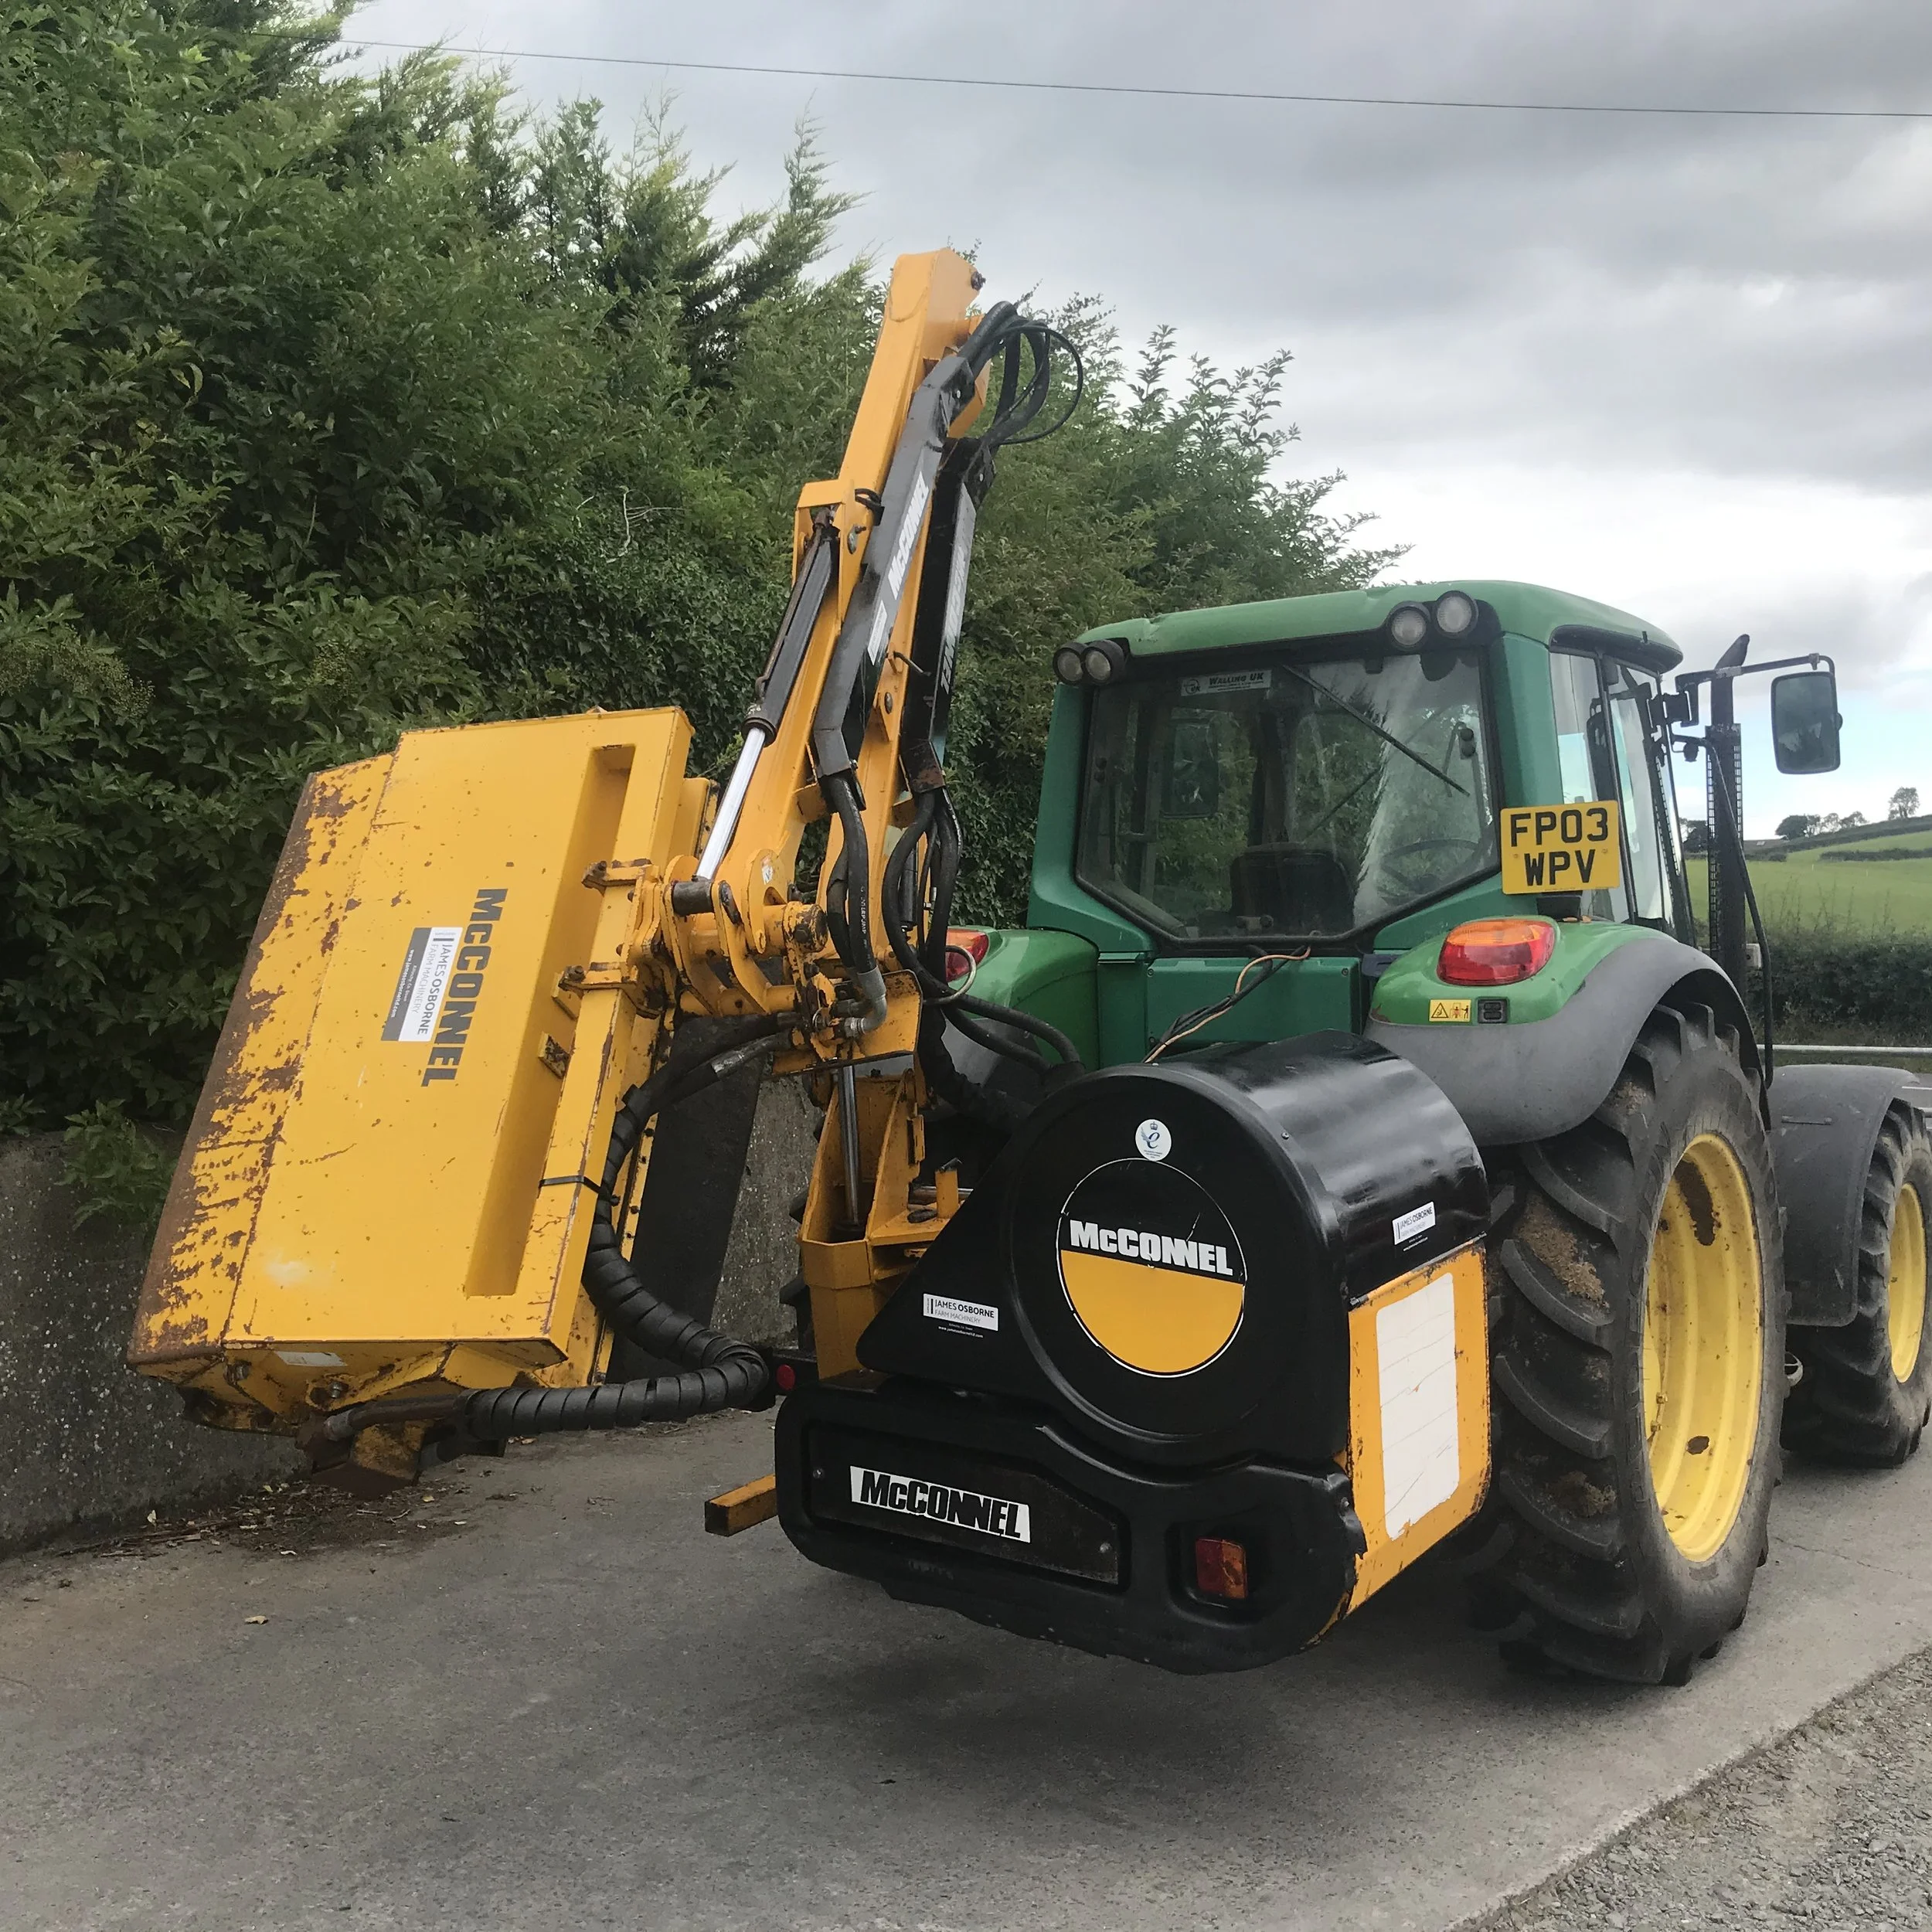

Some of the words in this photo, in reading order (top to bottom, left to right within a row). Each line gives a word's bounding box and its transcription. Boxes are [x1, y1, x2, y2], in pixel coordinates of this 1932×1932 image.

[1250, 672, 1264, 681] UK
[1510, 808, 1608, 847] FP03
[1524, 849, 1596, 886] WPV
[424, 944, 439, 966] FARM
[434, 944, 453, 977] JAMES
[412, 967, 430, 1014] MACHINERY
[417, 978, 443, 1036] OSBORNE
[420, 889, 509, 1087] McCONNEL
[1070, 1219, 1233, 1276] McCONNEL
[934, 1299, 957, 1311] JAMES
[957, 1304, 995, 1318] OSBORNE
[860, 1470, 1021, 1539] McCONNEL
